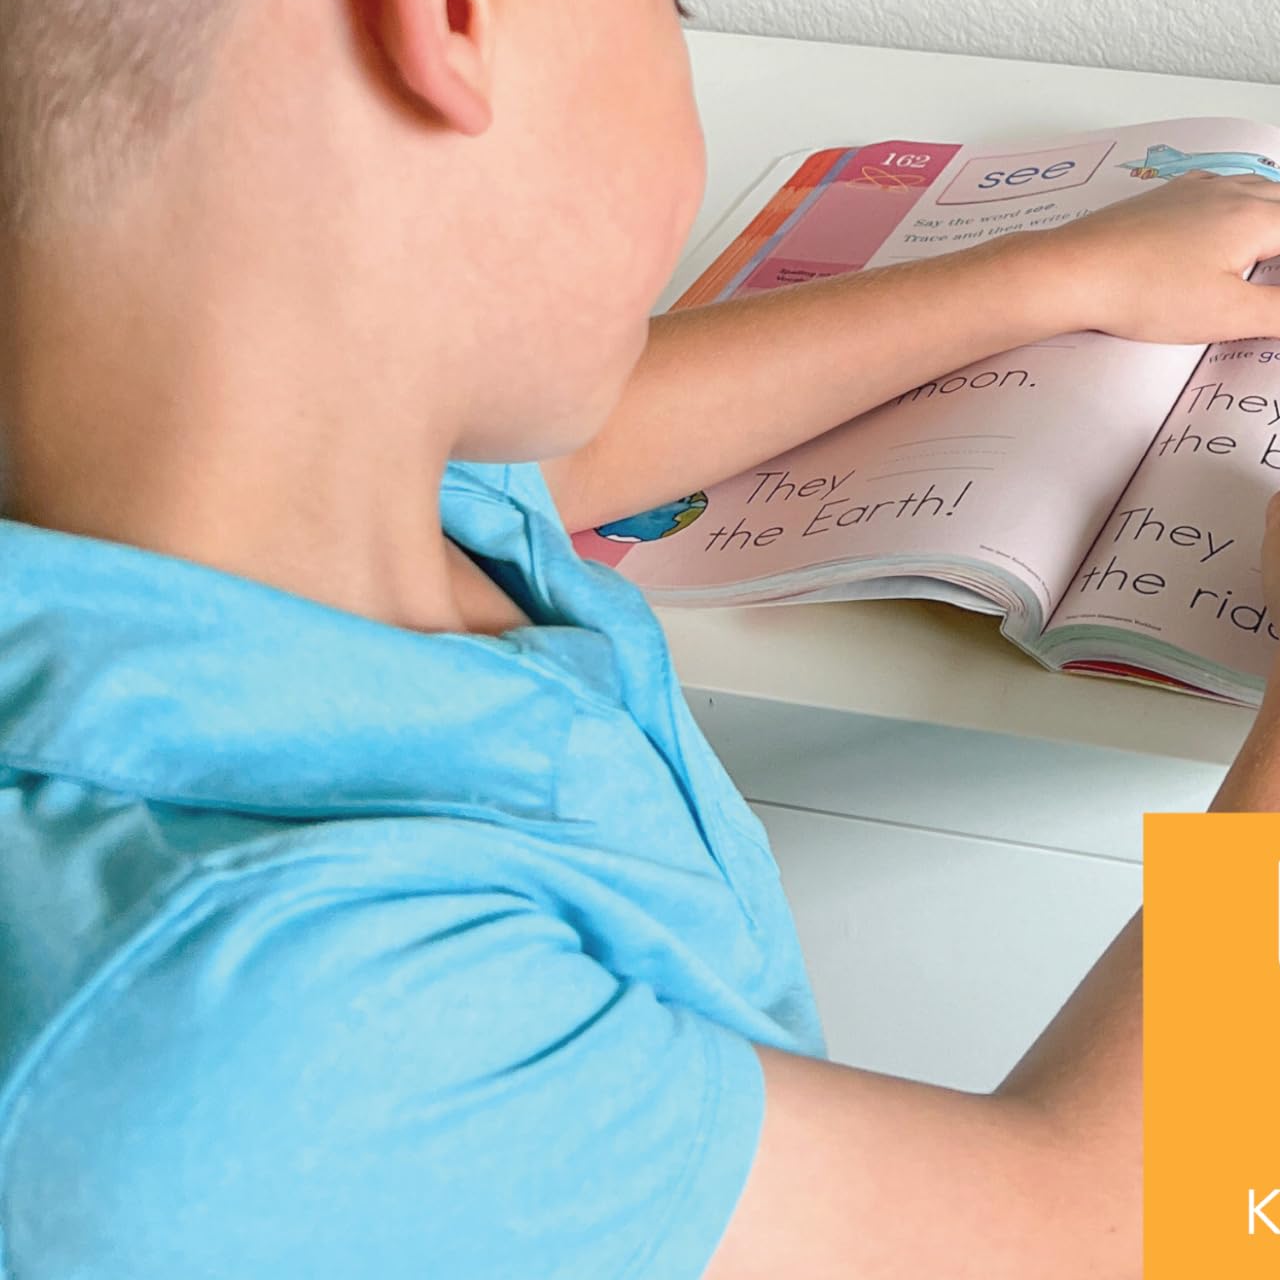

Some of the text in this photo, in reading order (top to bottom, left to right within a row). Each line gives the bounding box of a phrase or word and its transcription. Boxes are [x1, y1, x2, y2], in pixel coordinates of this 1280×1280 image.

[881, 152, 931, 168] 162
[978, 160, 1076, 189] see
[897, 370, 1036, 405] moon.
[1159, 424, 1237, 457] the
[747, 469, 855, 504] They
[705, 481, 972, 552] the Earth!
[1114, 507, 1234, 562] They
[1080, 556, 1166, 595] the
